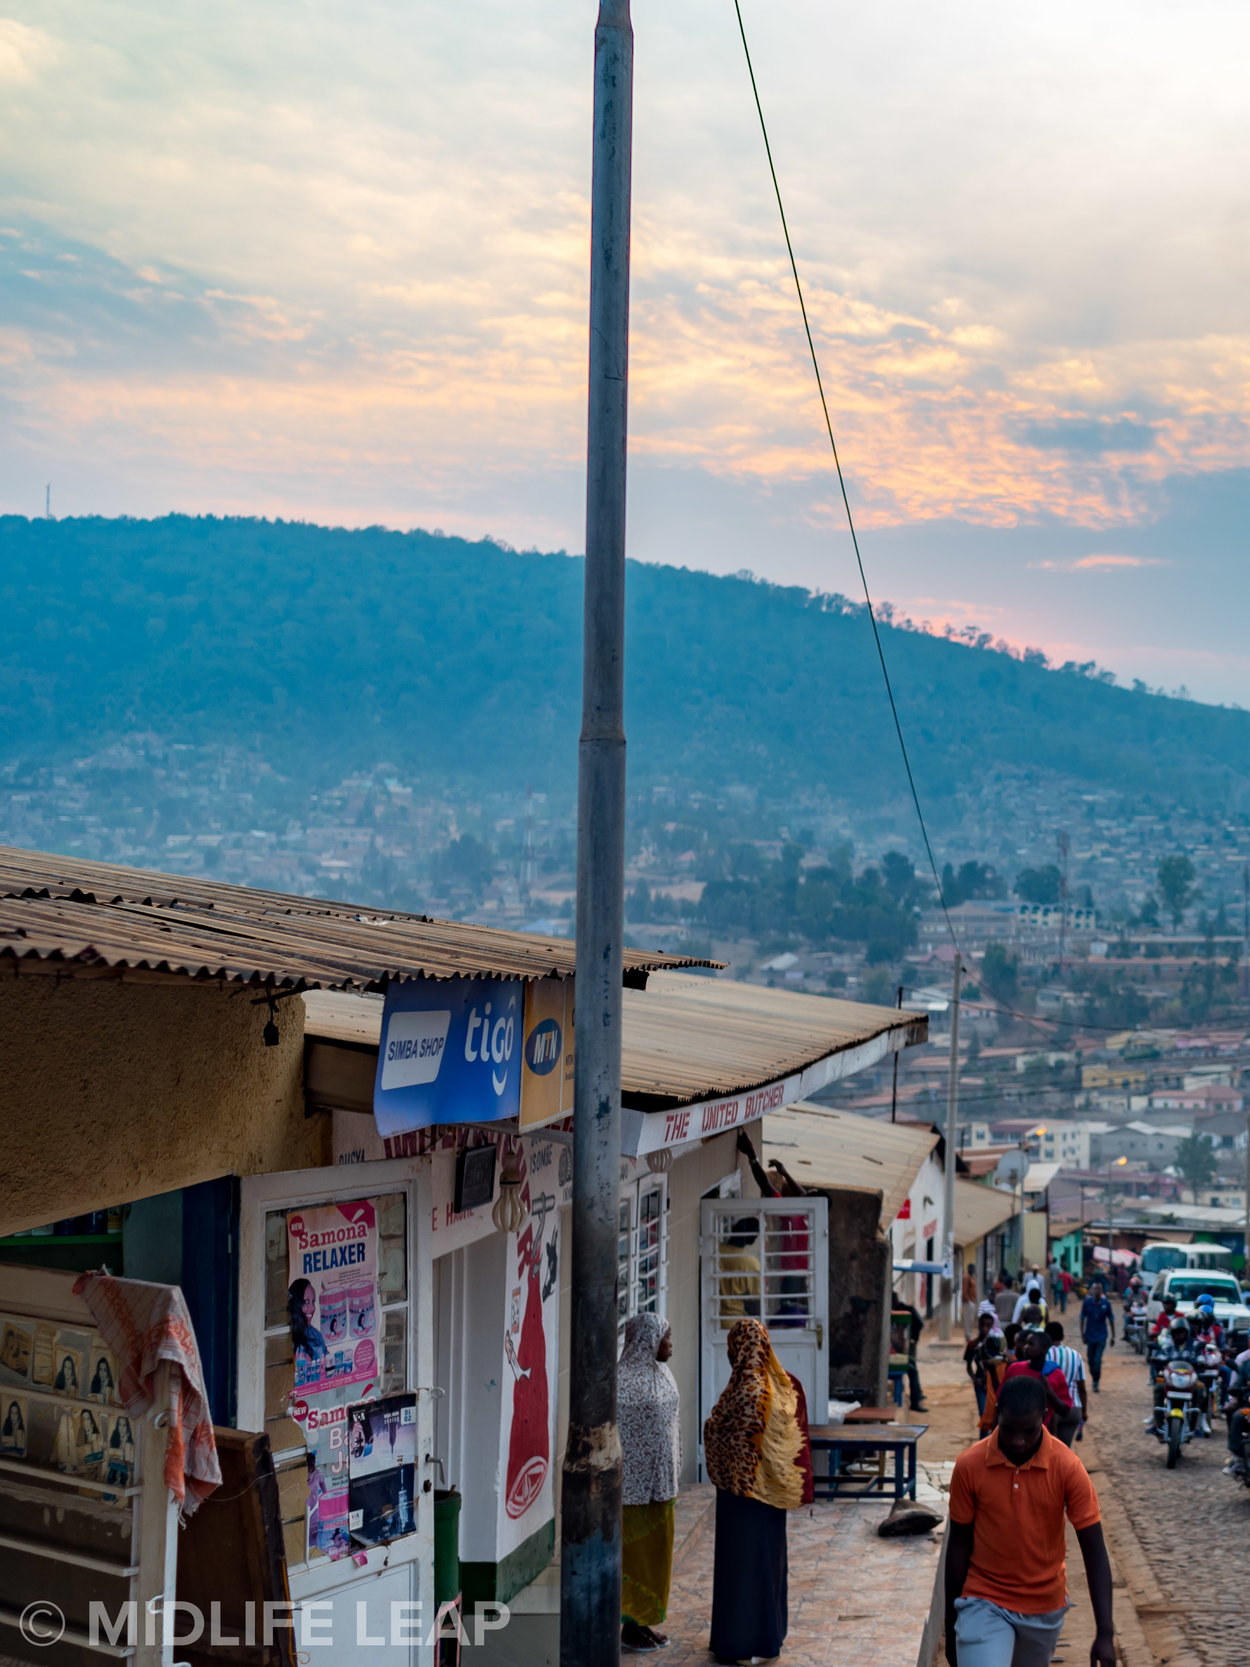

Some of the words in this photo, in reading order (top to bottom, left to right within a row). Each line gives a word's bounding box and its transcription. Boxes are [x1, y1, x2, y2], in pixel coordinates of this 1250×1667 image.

[387, 1039, 418, 1062] SIMBA
[419, 1036, 445, 1057] SHOP
[532, 1030, 558, 1065] MTN
[664, 1111, 691, 1143] THE
[701, 1100, 739, 1133] UNITED
[744, 1084, 785, 1120] BUTCHER
[303, 1242, 366, 1275] RELAXER
[293, 1406, 307, 1416] NEW
